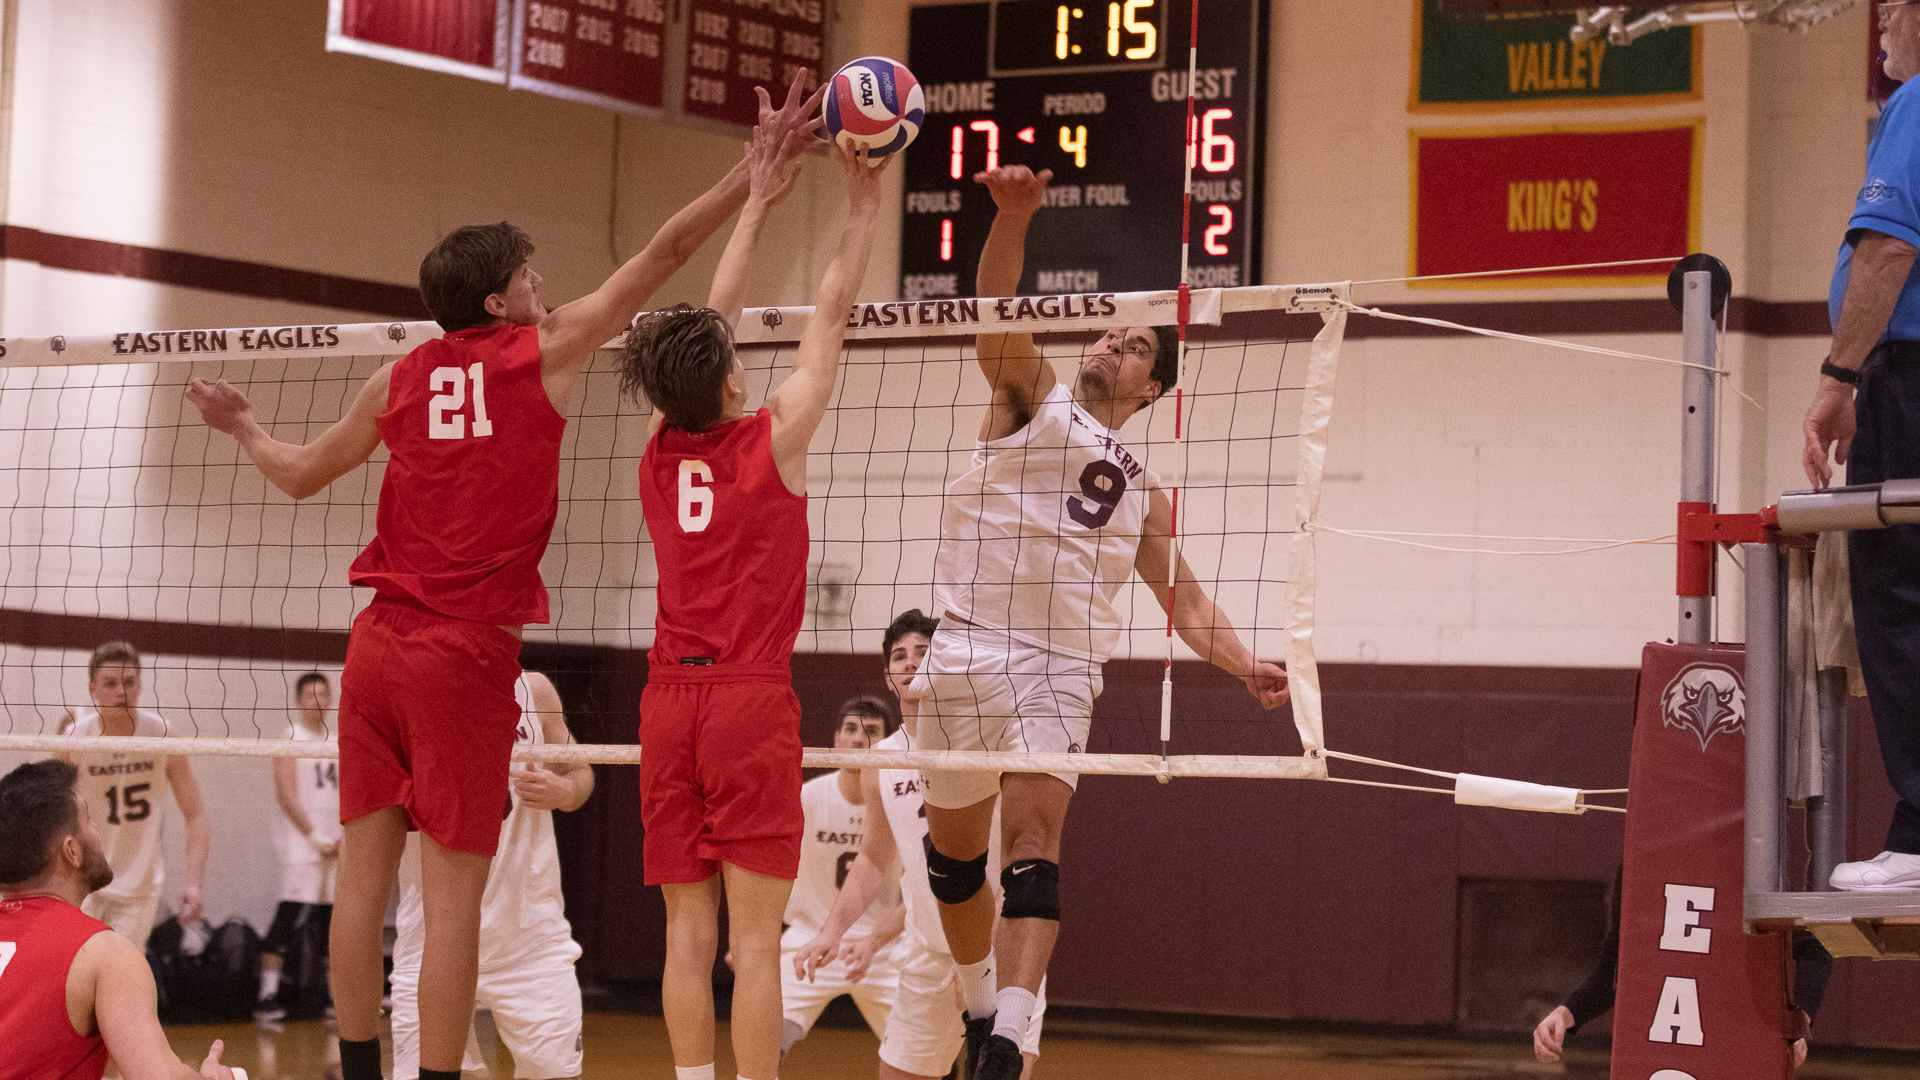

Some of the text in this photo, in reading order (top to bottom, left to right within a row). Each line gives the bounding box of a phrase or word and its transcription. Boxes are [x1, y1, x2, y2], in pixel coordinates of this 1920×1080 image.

[1507, 40, 1606, 92] VALLEY
[859, 72, 874, 107] NCAA
[881, 71, 894, 104] molten
[924, 81, 996, 114] HOME
[1151, 67, 1238, 102] GUEST
[1043, 92, 1107, 116] PERIOD
[950, 120, 1000, 179] 17
[1059, 125, 1088, 169] 4
[906, 190, 962, 214] FOULS
[1084, 184, 1129, 207] FOUL
[1507, 179, 1600, 233] KING'S
[940, 218, 953, 261] 1
[1204, 204, 1234, 256] 2
[904, 273, 959, 297] SCORE
[1036, 270, 1099, 293] MATCH
[1302, 287, 1333, 295] Senoh
[994, 294, 1117, 321] EAGLES
[112, 325, 340, 354] EASTERN EAGLES
[428, 361, 494, 440] 21
[677, 458, 715, 533] 6
[1065, 459, 1128, 530] 9
[87, 760, 154, 777] EASTERN
[104, 782, 152, 826] 15
